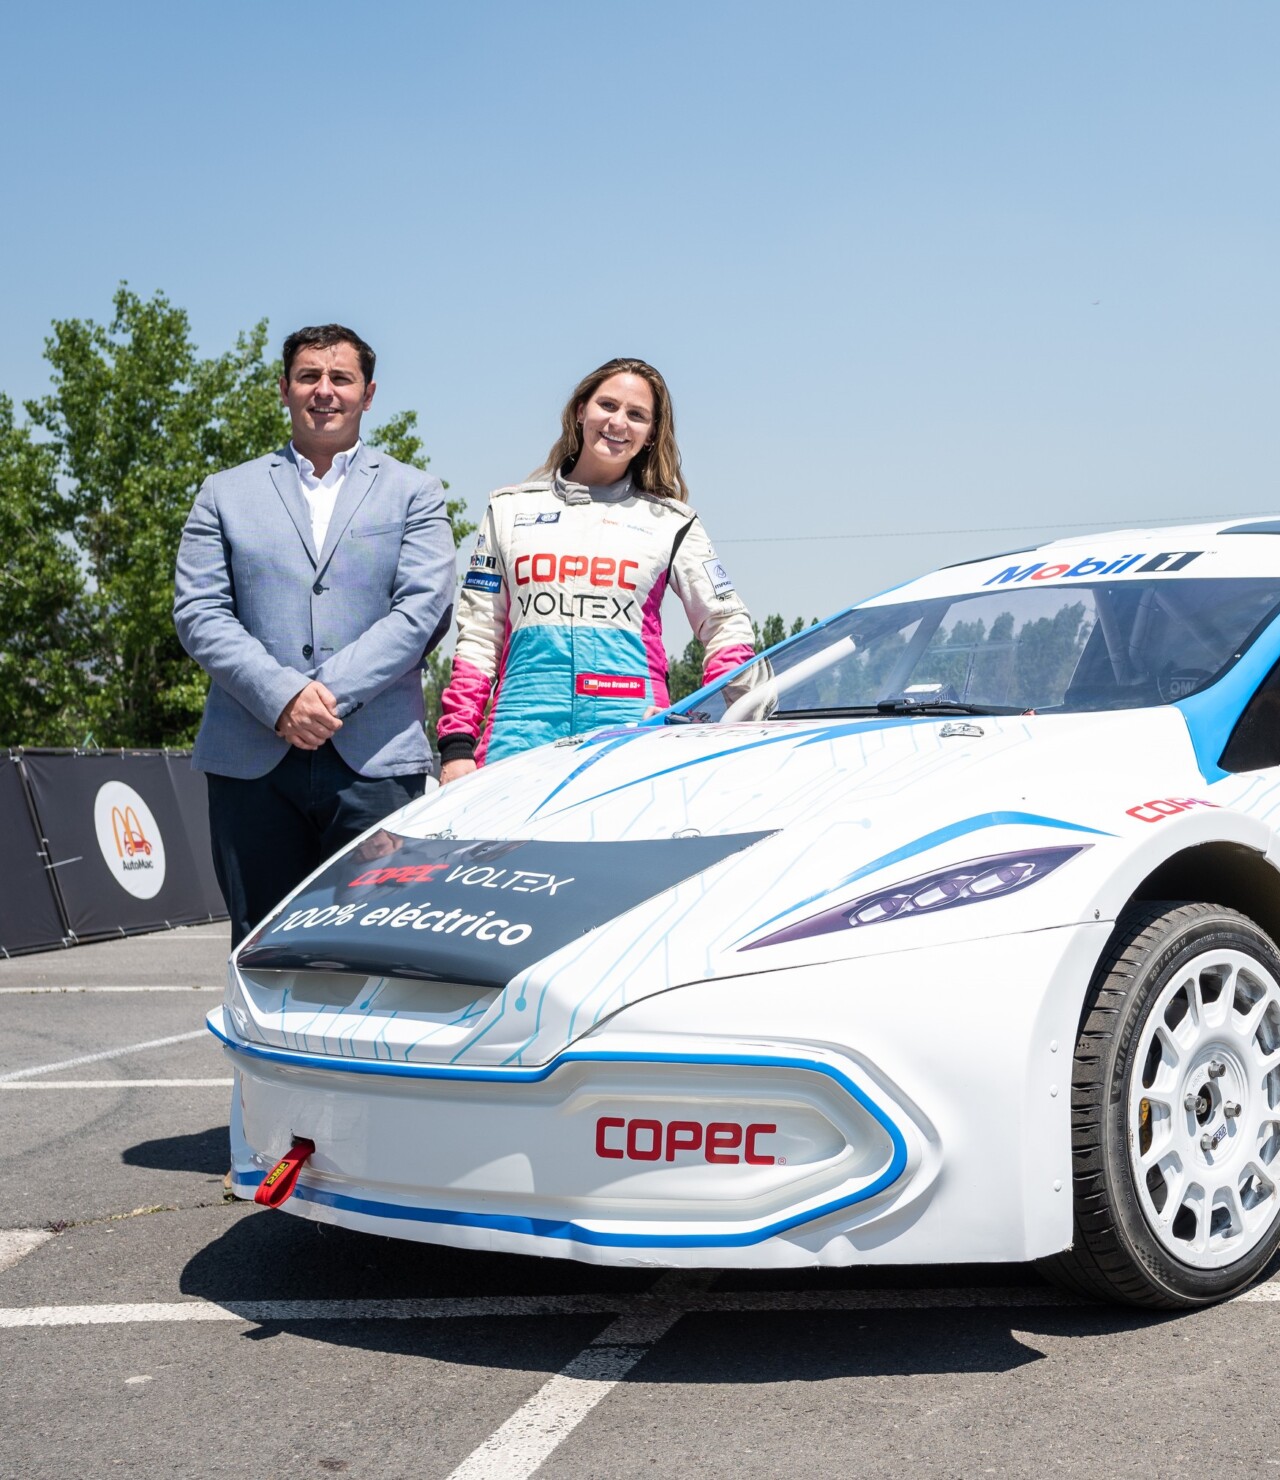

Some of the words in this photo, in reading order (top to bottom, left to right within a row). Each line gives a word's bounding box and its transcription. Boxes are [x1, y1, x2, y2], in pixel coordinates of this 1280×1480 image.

[514, 553, 639, 591] COPEC
[982, 553, 1147, 587] Mobil
[517, 592, 635, 622] VOLTEX
[122, 859, 154, 871] AutoMac
[445, 865, 575, 896] VOLTEX
[271, 902, 368, 934] 100%
[359, 901, 533, 946] eléctrico
[1115, 985, 1149, 1076] MICHELIN
[595, 1116, 777, 1166] COPEC
[266, 1162, 289, 1186] OMP
